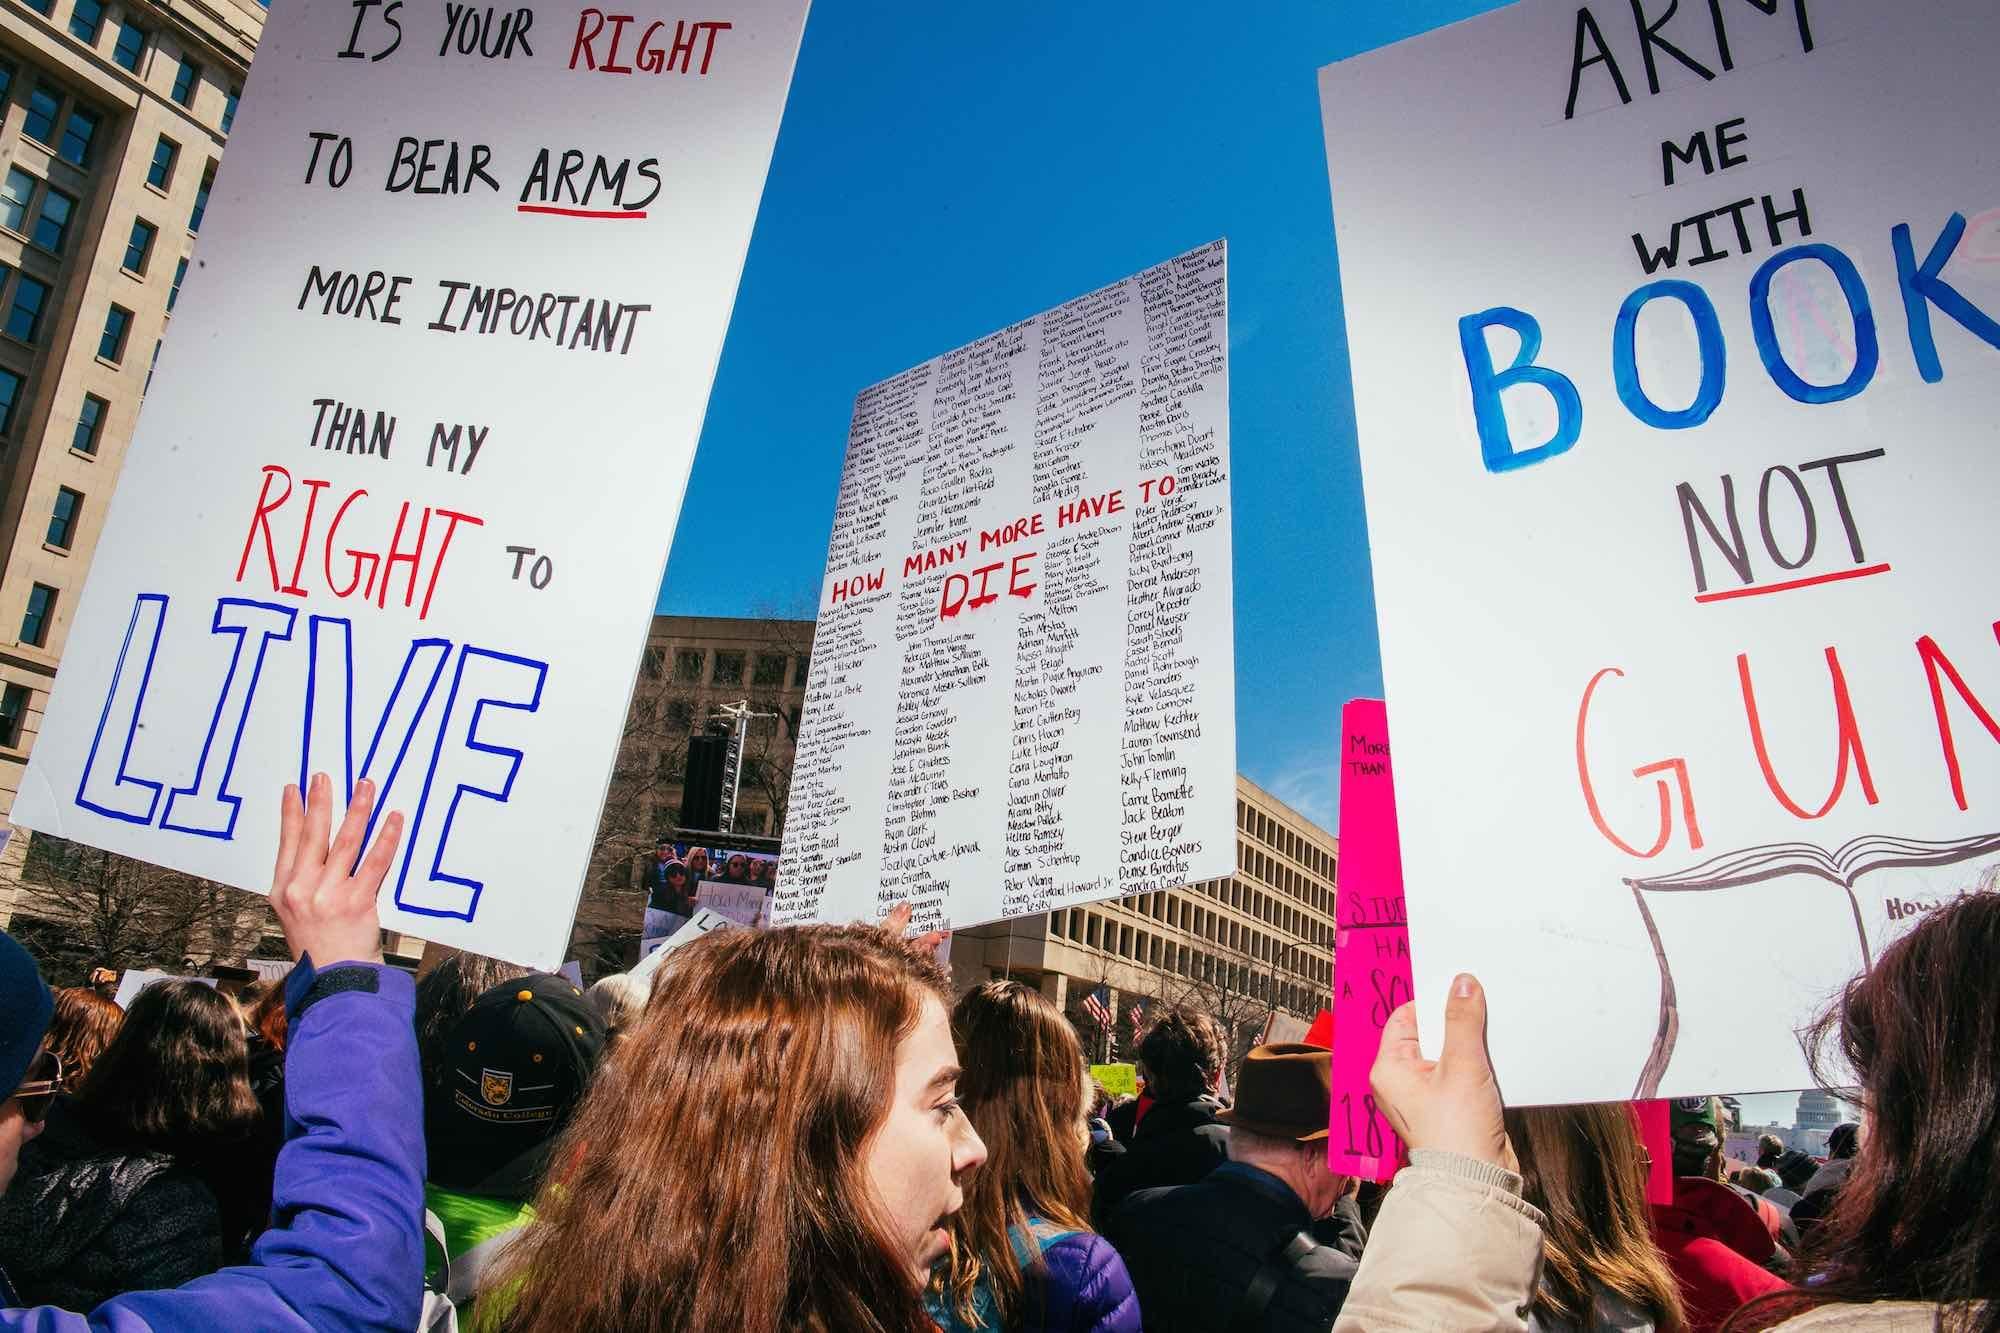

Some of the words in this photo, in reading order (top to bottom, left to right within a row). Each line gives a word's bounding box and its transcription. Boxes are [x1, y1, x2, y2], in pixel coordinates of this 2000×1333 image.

[337, 0, 402, 61] IS
[438, 3, 534, 57] YOUR
[569, 8, 731, 74] RIGHT
[1565, 0, 1814, 119] ARM
[305, 132, 352, 185] TO
[386, 137, 499, 194] BEAR
[520, 149, 661, 210] ARMS
[1662, 118, 1748, 186] ME
[1631, 188, 1812, 274] WITH
[298, 267, 412, 323] MORE
[428, 281, 651, 355] IMPORTANT
[311, 400, 396, 459] THAN
[427, 423, 489, 474] MY
[237, 466, 483, 619] RIGHT
[506, 546, 552, 590] TO
[832, 568, 885, 604] HOW
[904, 540, 967, 577] MANY
[980, 513, 1045, 552] MORE
[1058, 489, 1125, 528] HAVE
[1139, 475, 1175, 503] TO
[1676, 448, 1885, 592] NOT
[940, 552, 1037, 622] DIE
[1125, 681, 1145, 691] Dave
[1146, 672, 1182, 686] Sanders
[75, 594, 548, 922] LIVE
[1121, 752, 1145, 768] John
[1144, 746, 1175, 762] Tomlin
[1153, 723, 1200, 743] Townsend
[1348, 762, 1386, 776] THAN
[1121, 772, 1141, 789] Kelly
[1121, 831, 1147, 845] Steve
[1122, 809, 1146, 825] Jack
[1343, 980, 1353, 999] A
[1371, 968, 1411, 1029] SC
